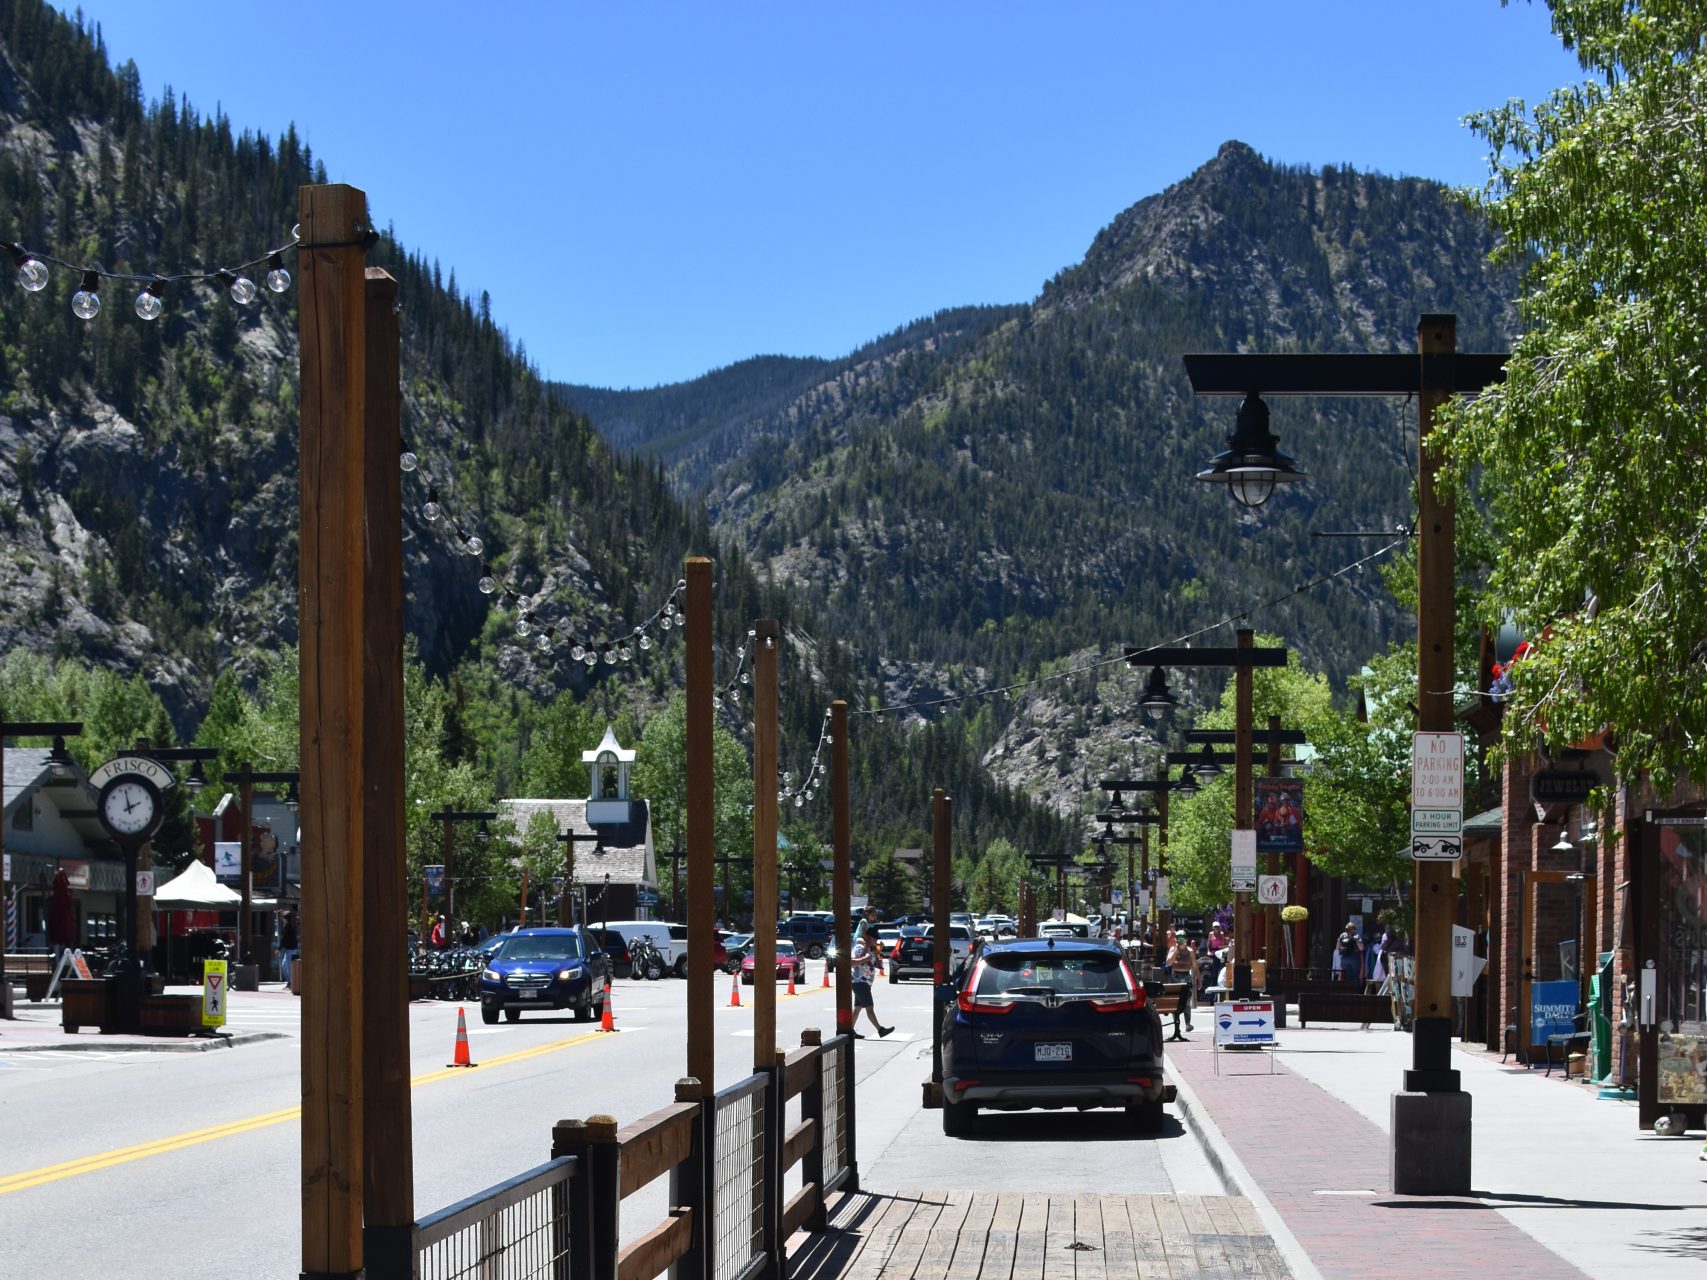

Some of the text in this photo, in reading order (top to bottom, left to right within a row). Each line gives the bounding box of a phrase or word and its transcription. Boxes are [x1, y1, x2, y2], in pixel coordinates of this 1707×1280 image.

[1430, 740, 1446, 754] NO
[104, 760, 158, 778] FRISCO
[1417, 757, 1459, 771] PARKING
[1421, 775, 1454, 785] 2:00 AM
[1416, 787, 1459, 798] TO 6:00 AM
[1415, 821, 1458, 829] PARKING LIMIT
[1534, 1004, 1571, 1012] SUMMIT
[1544, 1011, 1571, 1019] DAILY
